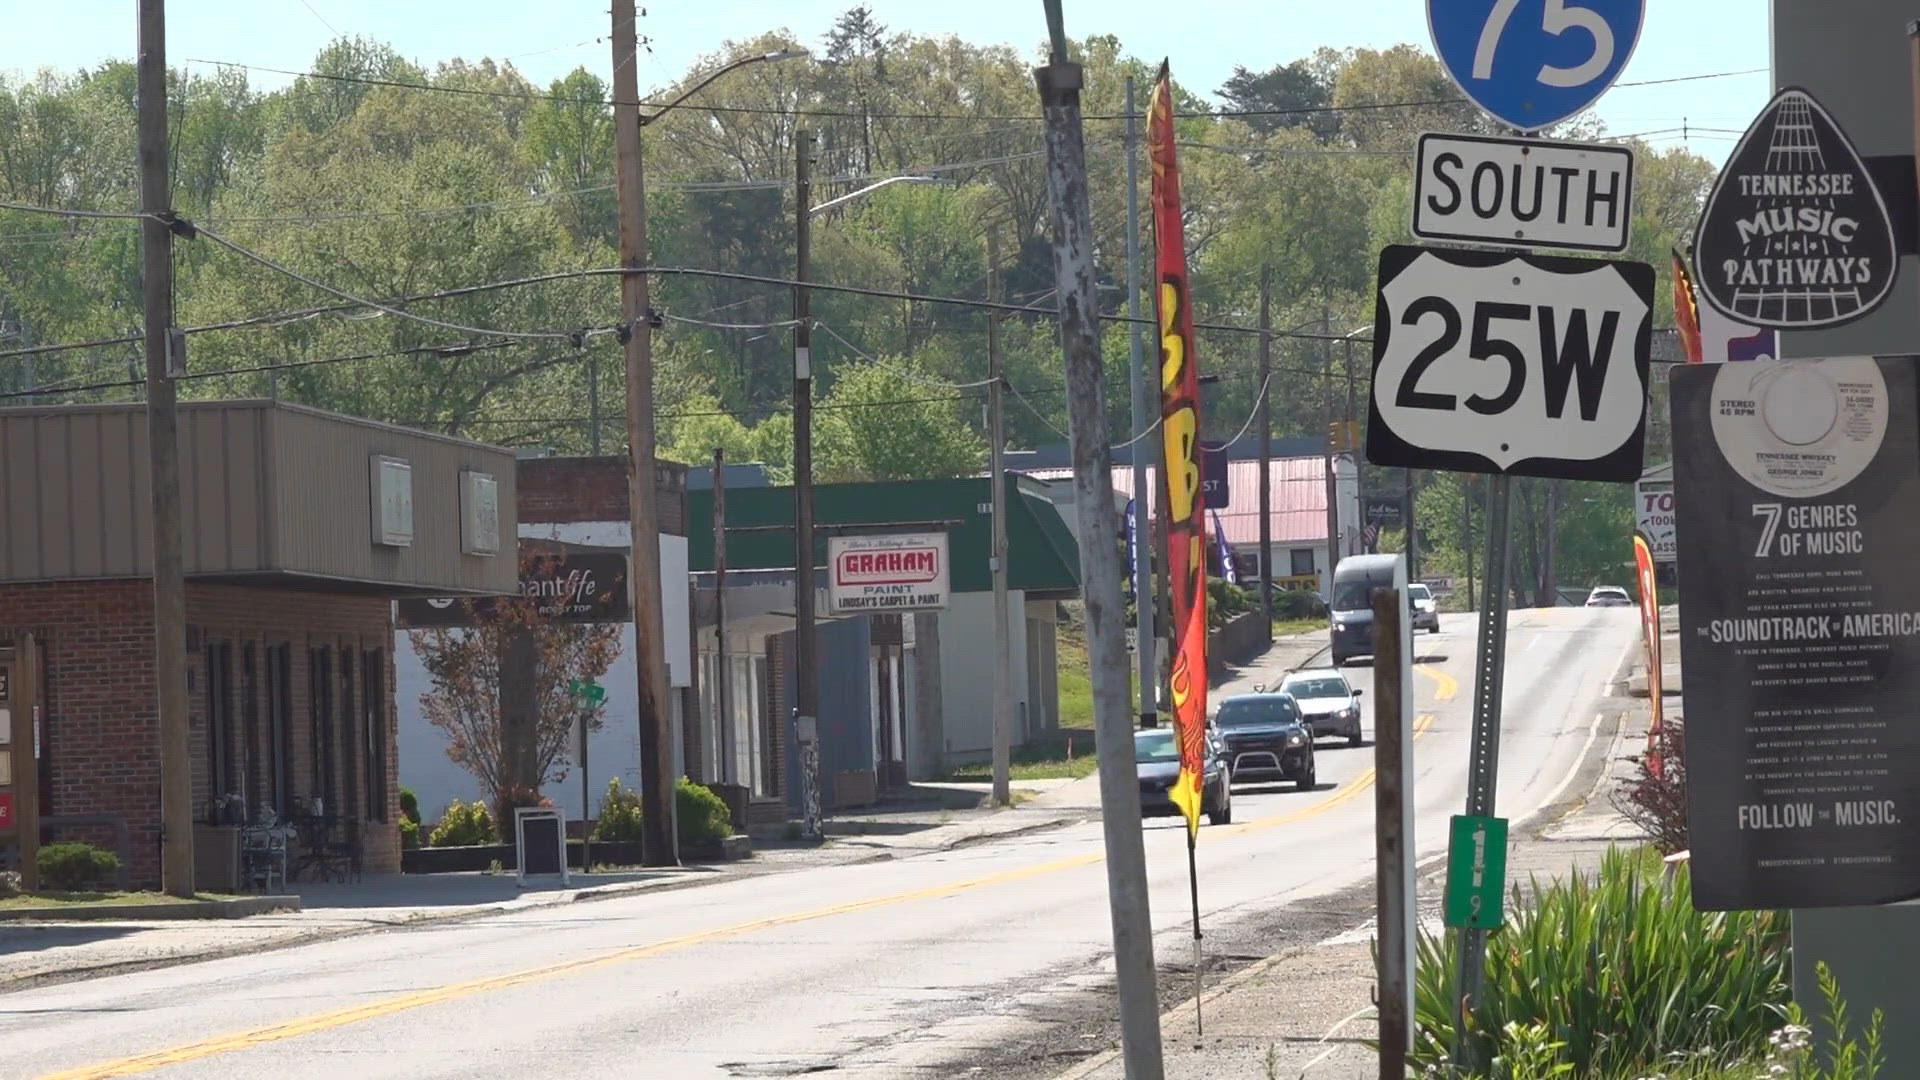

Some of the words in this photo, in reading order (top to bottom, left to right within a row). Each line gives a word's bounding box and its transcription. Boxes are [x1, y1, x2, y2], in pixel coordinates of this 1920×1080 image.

[1472, 0, 1614, 87] 75
[1428, 152, 1620, 228] SOUTH
[1738, 174, 1854, 196] TENNESSEE
[1736, 206, 1860, 244] MUSIC
[1723, 258, 1871, 285] PATHWAYS
[1395, 296, 1620, 422] 25W
[1752, 503, 1782, 557] 7
[1787, 504, 1857, 529] GENRES
[1780, 533, 1801, 556] OF
[1806, 530, 1863, 554] MUSIC
[845, 552, 934, 573] GRAHAM
[838, 596, 877, 608] LINDSAY'S
[879, 595, 907, 607] CARPET
[909, 595, 916, 605] &
[918, 594, 940, 605] PAINT
[864, 585, 914, 595] PAINT
[1697, 627, 1709, 636] THE
[1711, 616, 1831, 642] SOUNDTRACK
[1832, 622, 1841, 630] OF
[1843, 612, 1920, 638] AMERICA
[1738, 803, 1814, 830] FOLLOW
[1819, 810, 1830, 819] THE
[1835, 800, 1901, 826] MUSIC.
